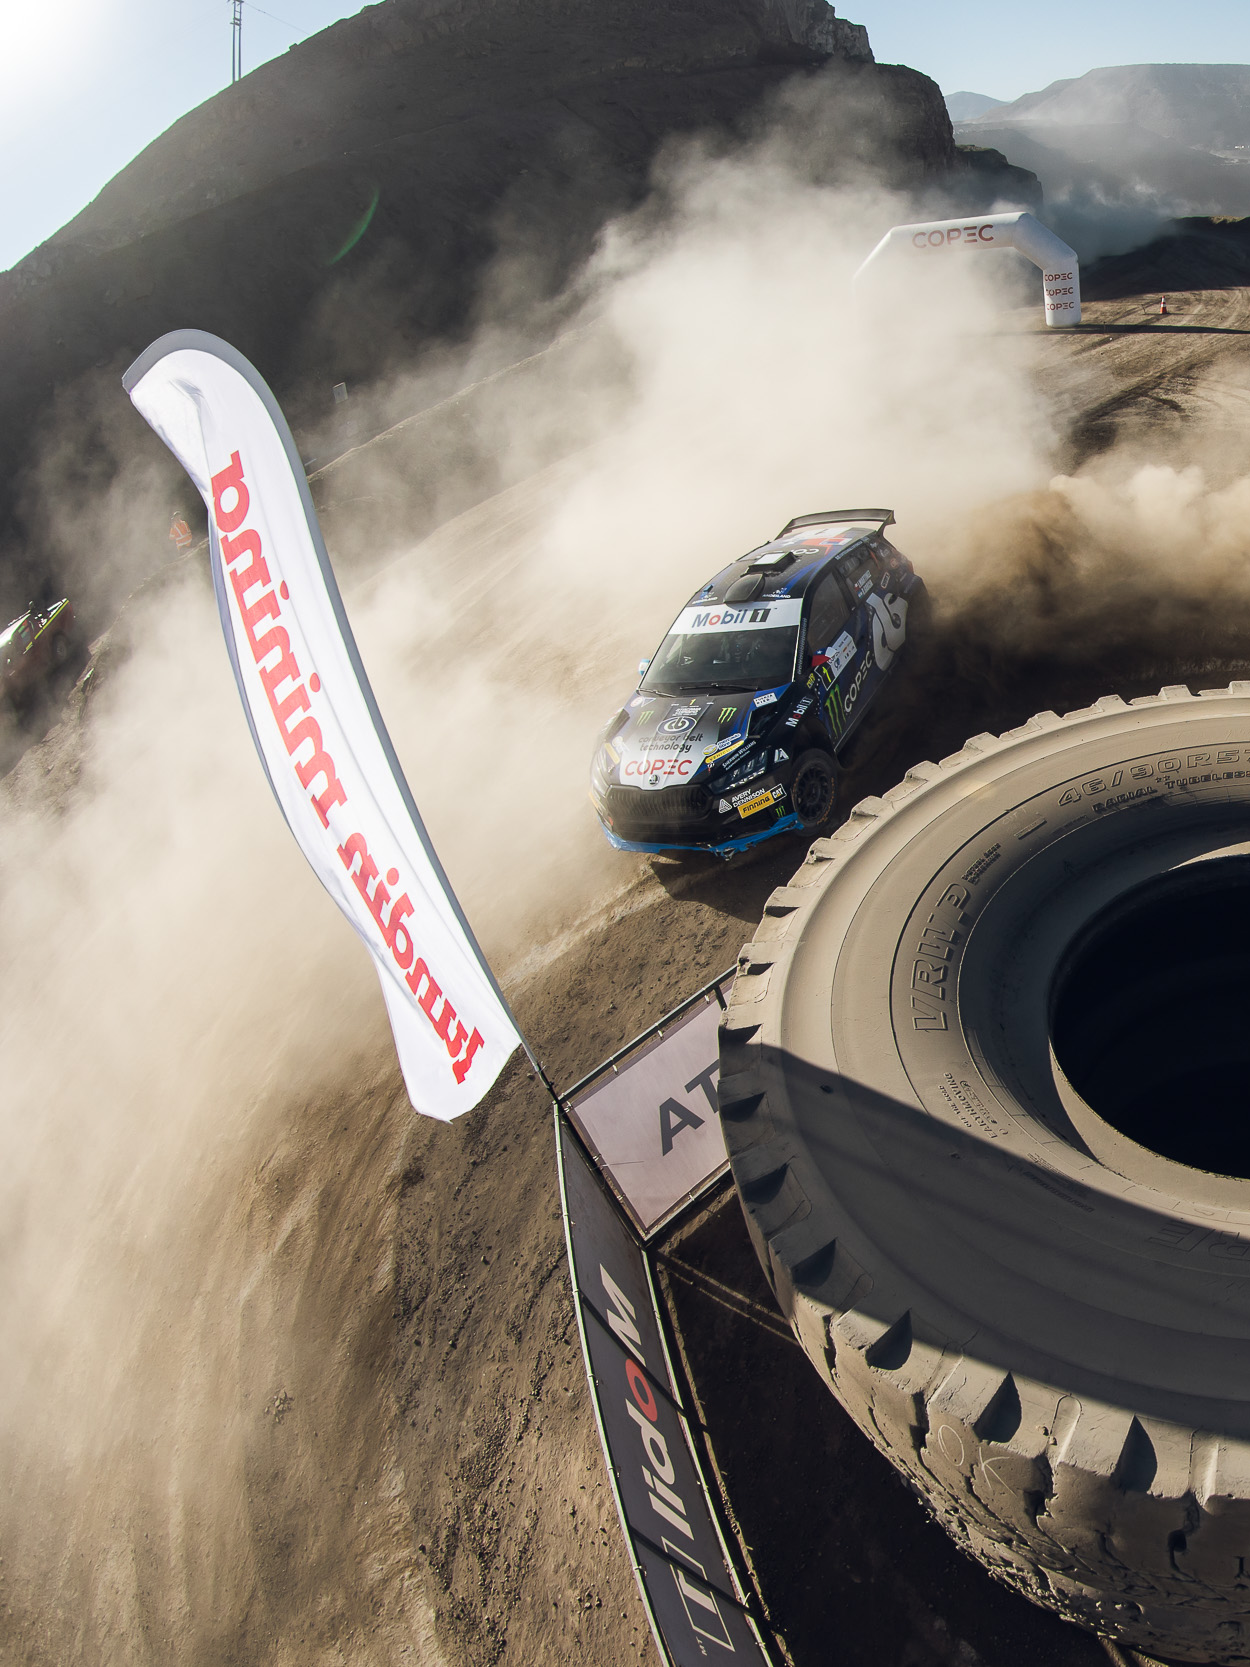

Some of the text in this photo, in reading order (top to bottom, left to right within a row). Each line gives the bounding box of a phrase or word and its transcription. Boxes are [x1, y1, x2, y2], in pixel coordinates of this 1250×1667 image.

[912, 223, 994, 249] COPEC
[1044, 272, 1073, 282] COPEC
[1046, 301, 1075, 311] COPEC
[691, 609, 748, 628] Mobil
[843, 651, 873, 716] COPEC
[785, 704, 808, 728] Mobil
[640, 741, 692, 753] technology
[624, 759, 693, 777] COPEC
[731, 788, 752, 803] AVERY
[733, 787, 766, 808] DENNISON
[772, 787, 784, 799] CAT
[1091, 786, 1158, 813] RADIAL
[742, 795, 771, 814] FINNING
[943, 1072, 998, 1139] EARTHMOVING
